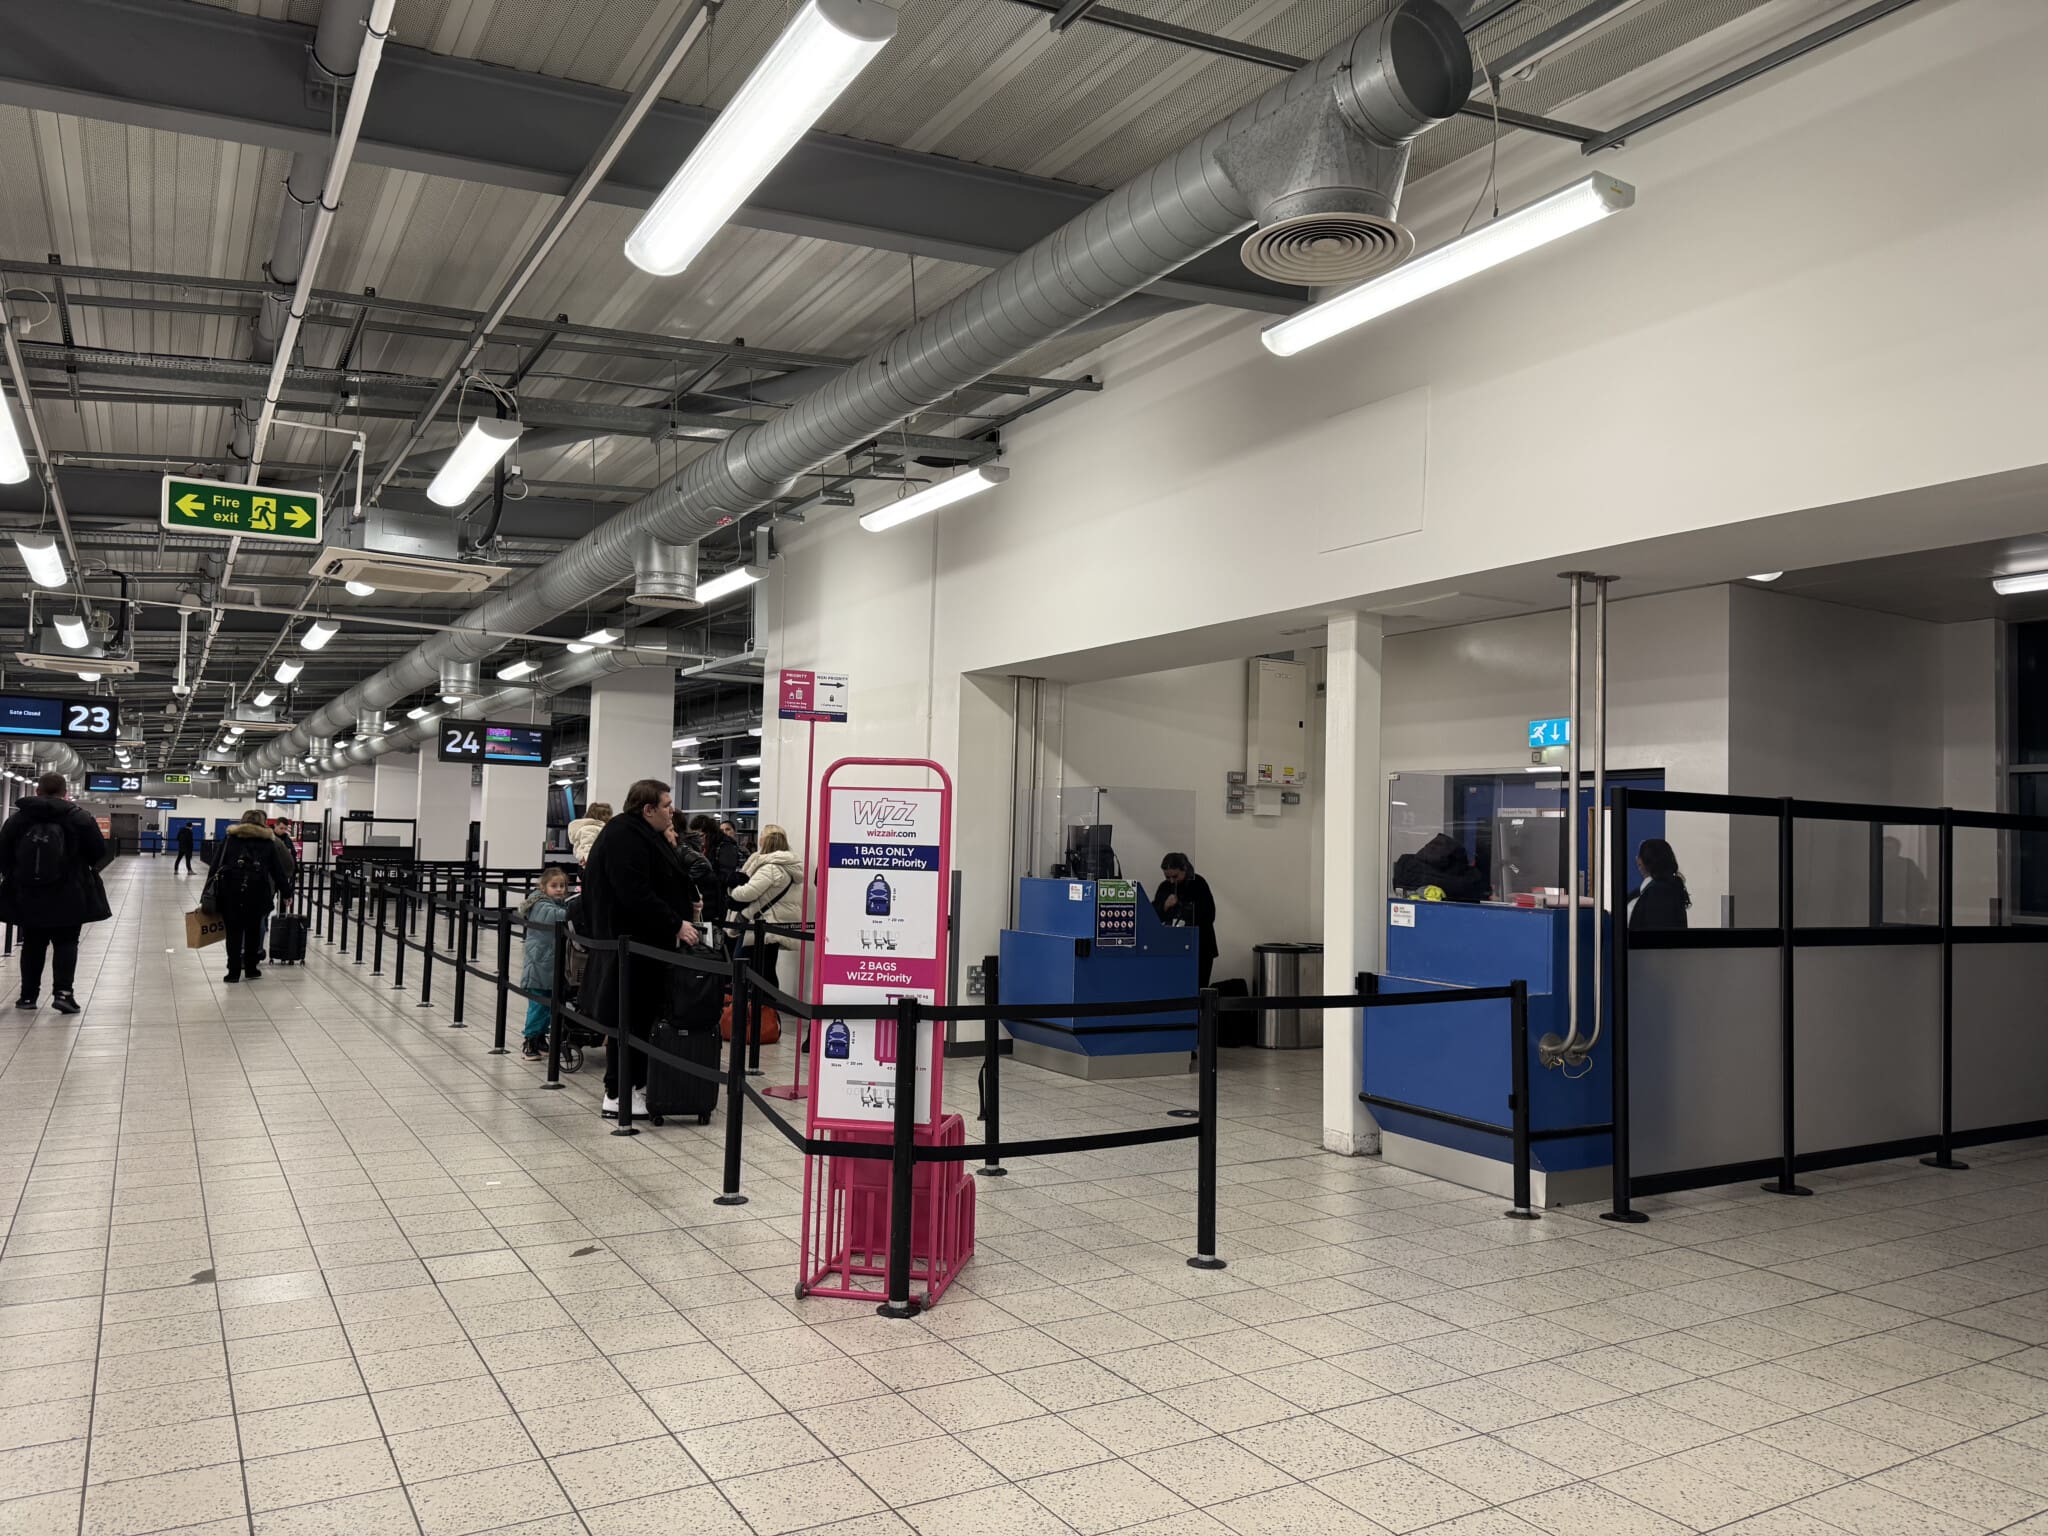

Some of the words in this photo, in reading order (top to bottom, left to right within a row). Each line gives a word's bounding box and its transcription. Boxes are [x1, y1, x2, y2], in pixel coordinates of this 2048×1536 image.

[213, 495, 240, 508] Fire
[213, 512, 239, 523] exit
[68, 705, 110, 733] 23
[446, 730, 480, 753] 24
[121, 778, 140, 789] 25
[257, 789, 267, 800] 2
[268, 785, 286, 796] 26
[866, 829, 917, 838] wizzair.com
[854, 846, 859, 855] 1
[861, 846, 883, 856] BAG
[885, 847, 915, 857] ONLY
[841, 858, 860, 866] non
[862, 857, 890, 867] WIZZ
[892, 858, 927, 869] Priority
[859, 961, 866, 970] 2
[868, 962, 897, 971] BAGS
[847, 971, 874, 981] WIZZ
[876, 972, 912, 984] Priority
